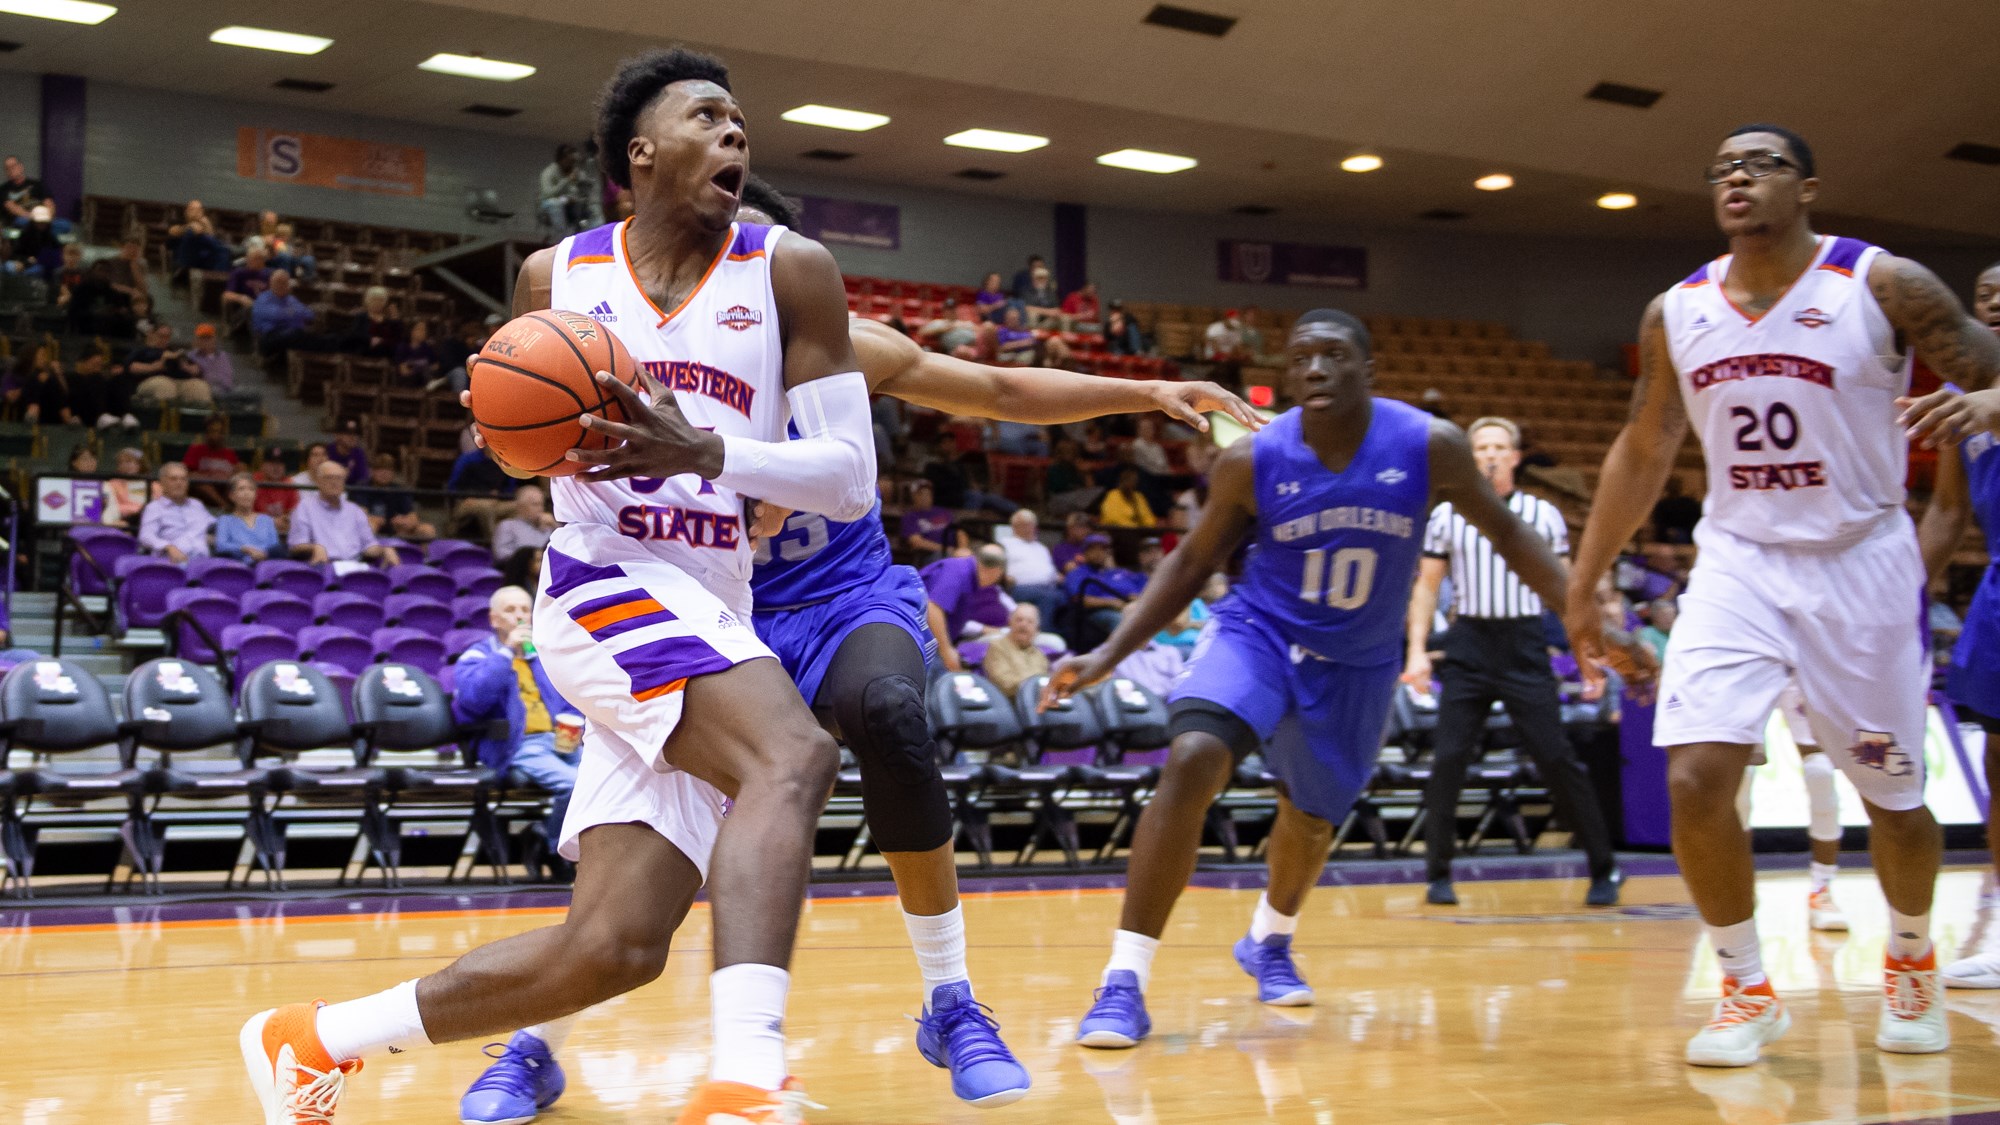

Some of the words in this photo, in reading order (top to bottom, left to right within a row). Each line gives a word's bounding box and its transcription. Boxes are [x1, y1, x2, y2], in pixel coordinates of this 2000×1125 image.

[271, 138, 300, 176] S
[641, 360, 757, 423] WESTERN
[1730, 401, 1800, 451] 20
[1729, 460, 1828, 490] STATE
[618, 504, 740, 552] STATE
[1299, 547, 1379, 611] 10
